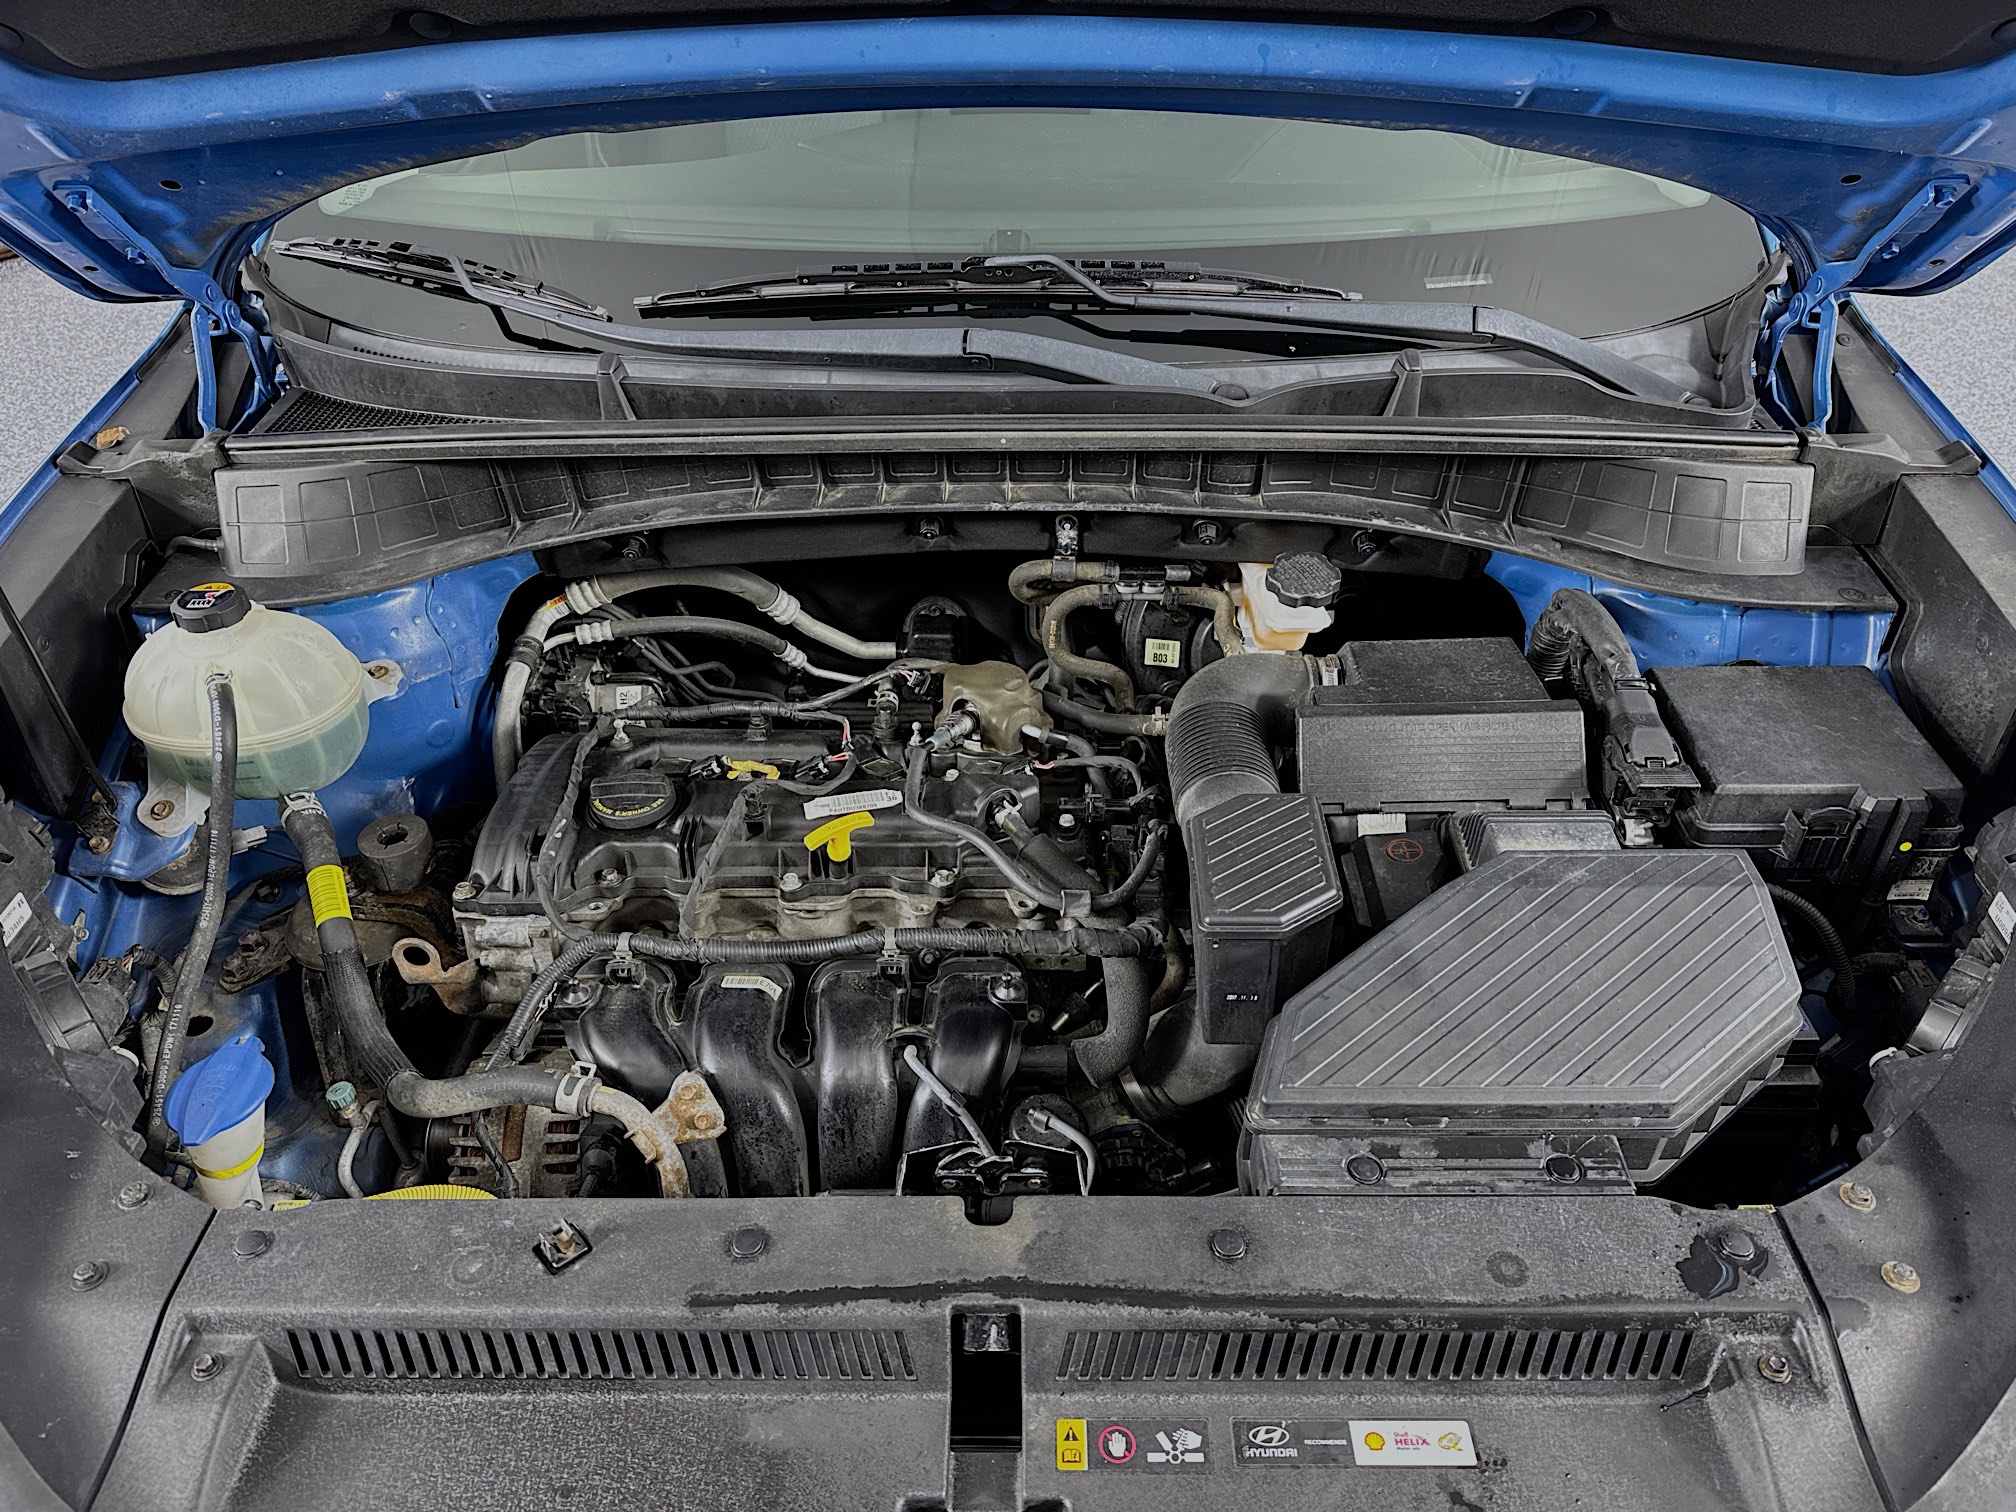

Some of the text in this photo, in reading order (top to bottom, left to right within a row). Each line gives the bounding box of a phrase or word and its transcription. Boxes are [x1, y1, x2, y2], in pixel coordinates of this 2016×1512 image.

[1153, 652, 1168, 663] B03
[620, 692, 628, 705] H2
[212, 699, 223, 752] 25451-D3000
[1429, 722, 1456, 732] OPEN
[168, 1004, 183, 1030] 171116
[1394, 1438, 1431, 1446] HELIX
[1246, 1448, 1298, 1457] HYUNDAI
